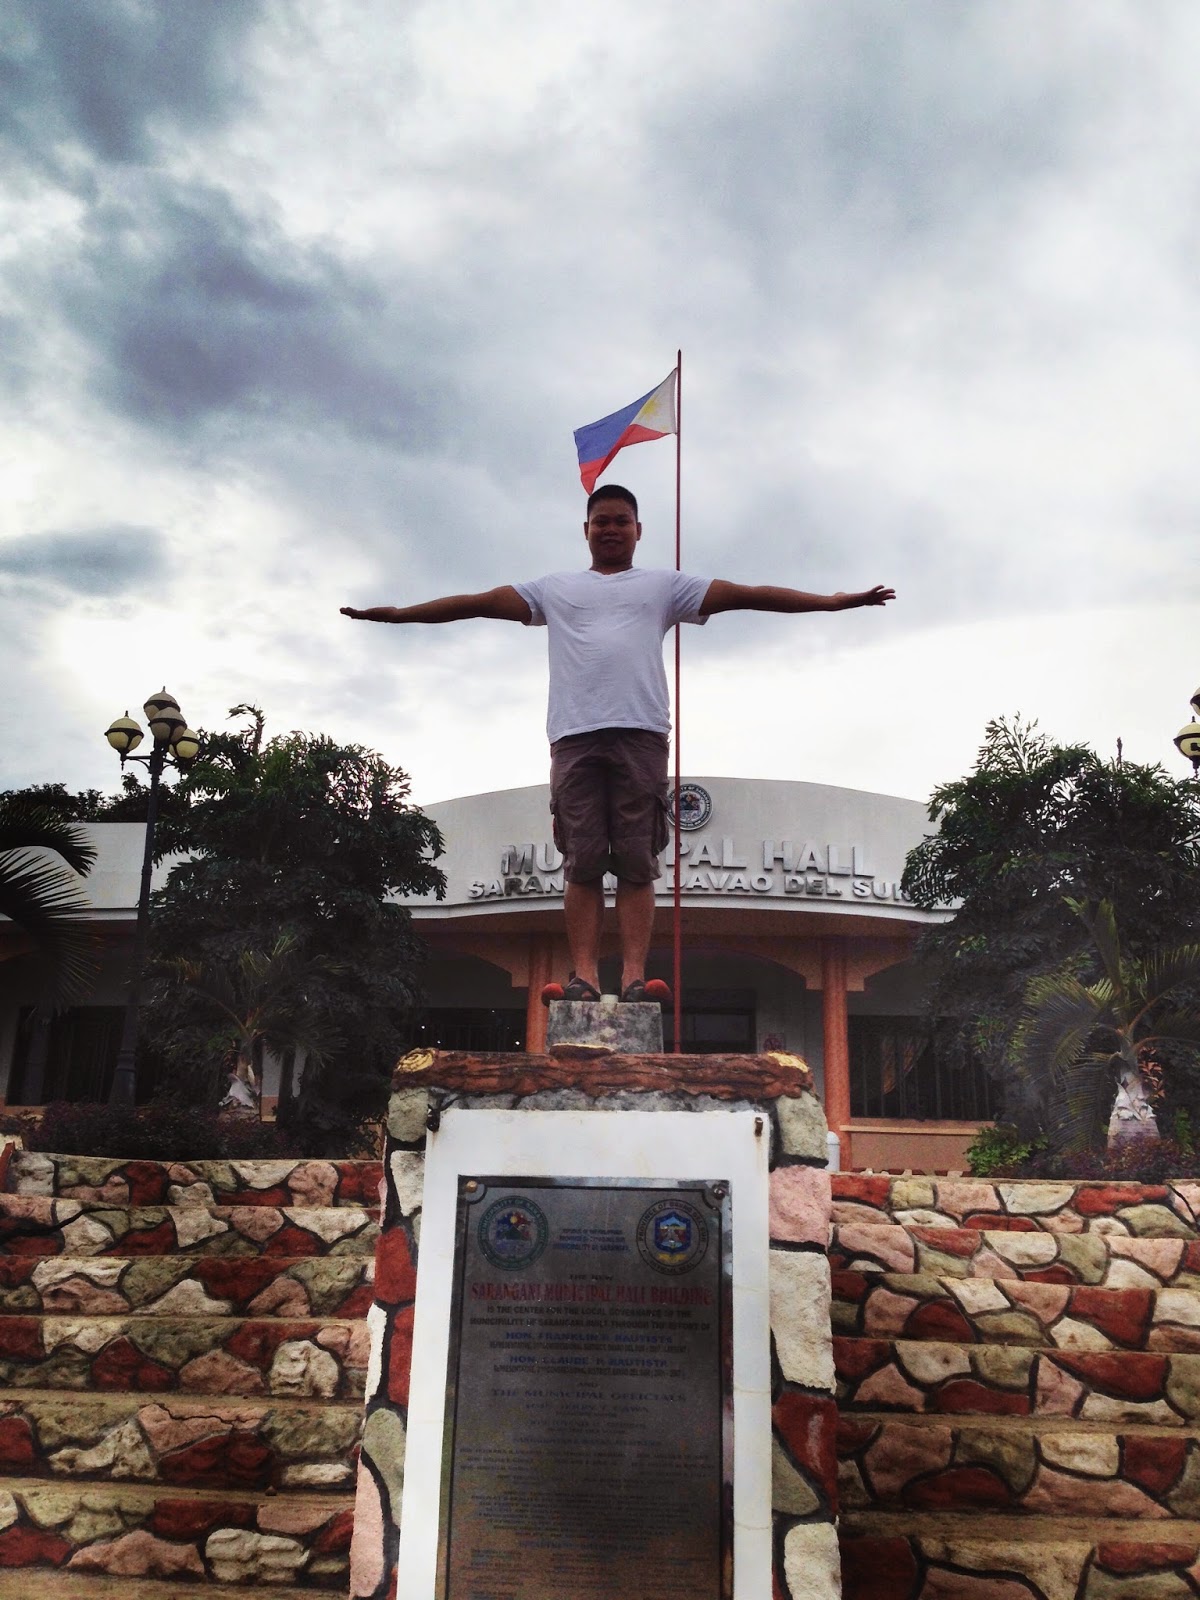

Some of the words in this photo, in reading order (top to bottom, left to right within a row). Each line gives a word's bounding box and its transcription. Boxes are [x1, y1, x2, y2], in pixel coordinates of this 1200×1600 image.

[500, 836, 747, 875] MUPAL
[763, 838, 875, 878] HALL
[666, 872, 774, 892] DAVAO
[784, 875, 843, 896] DEL
